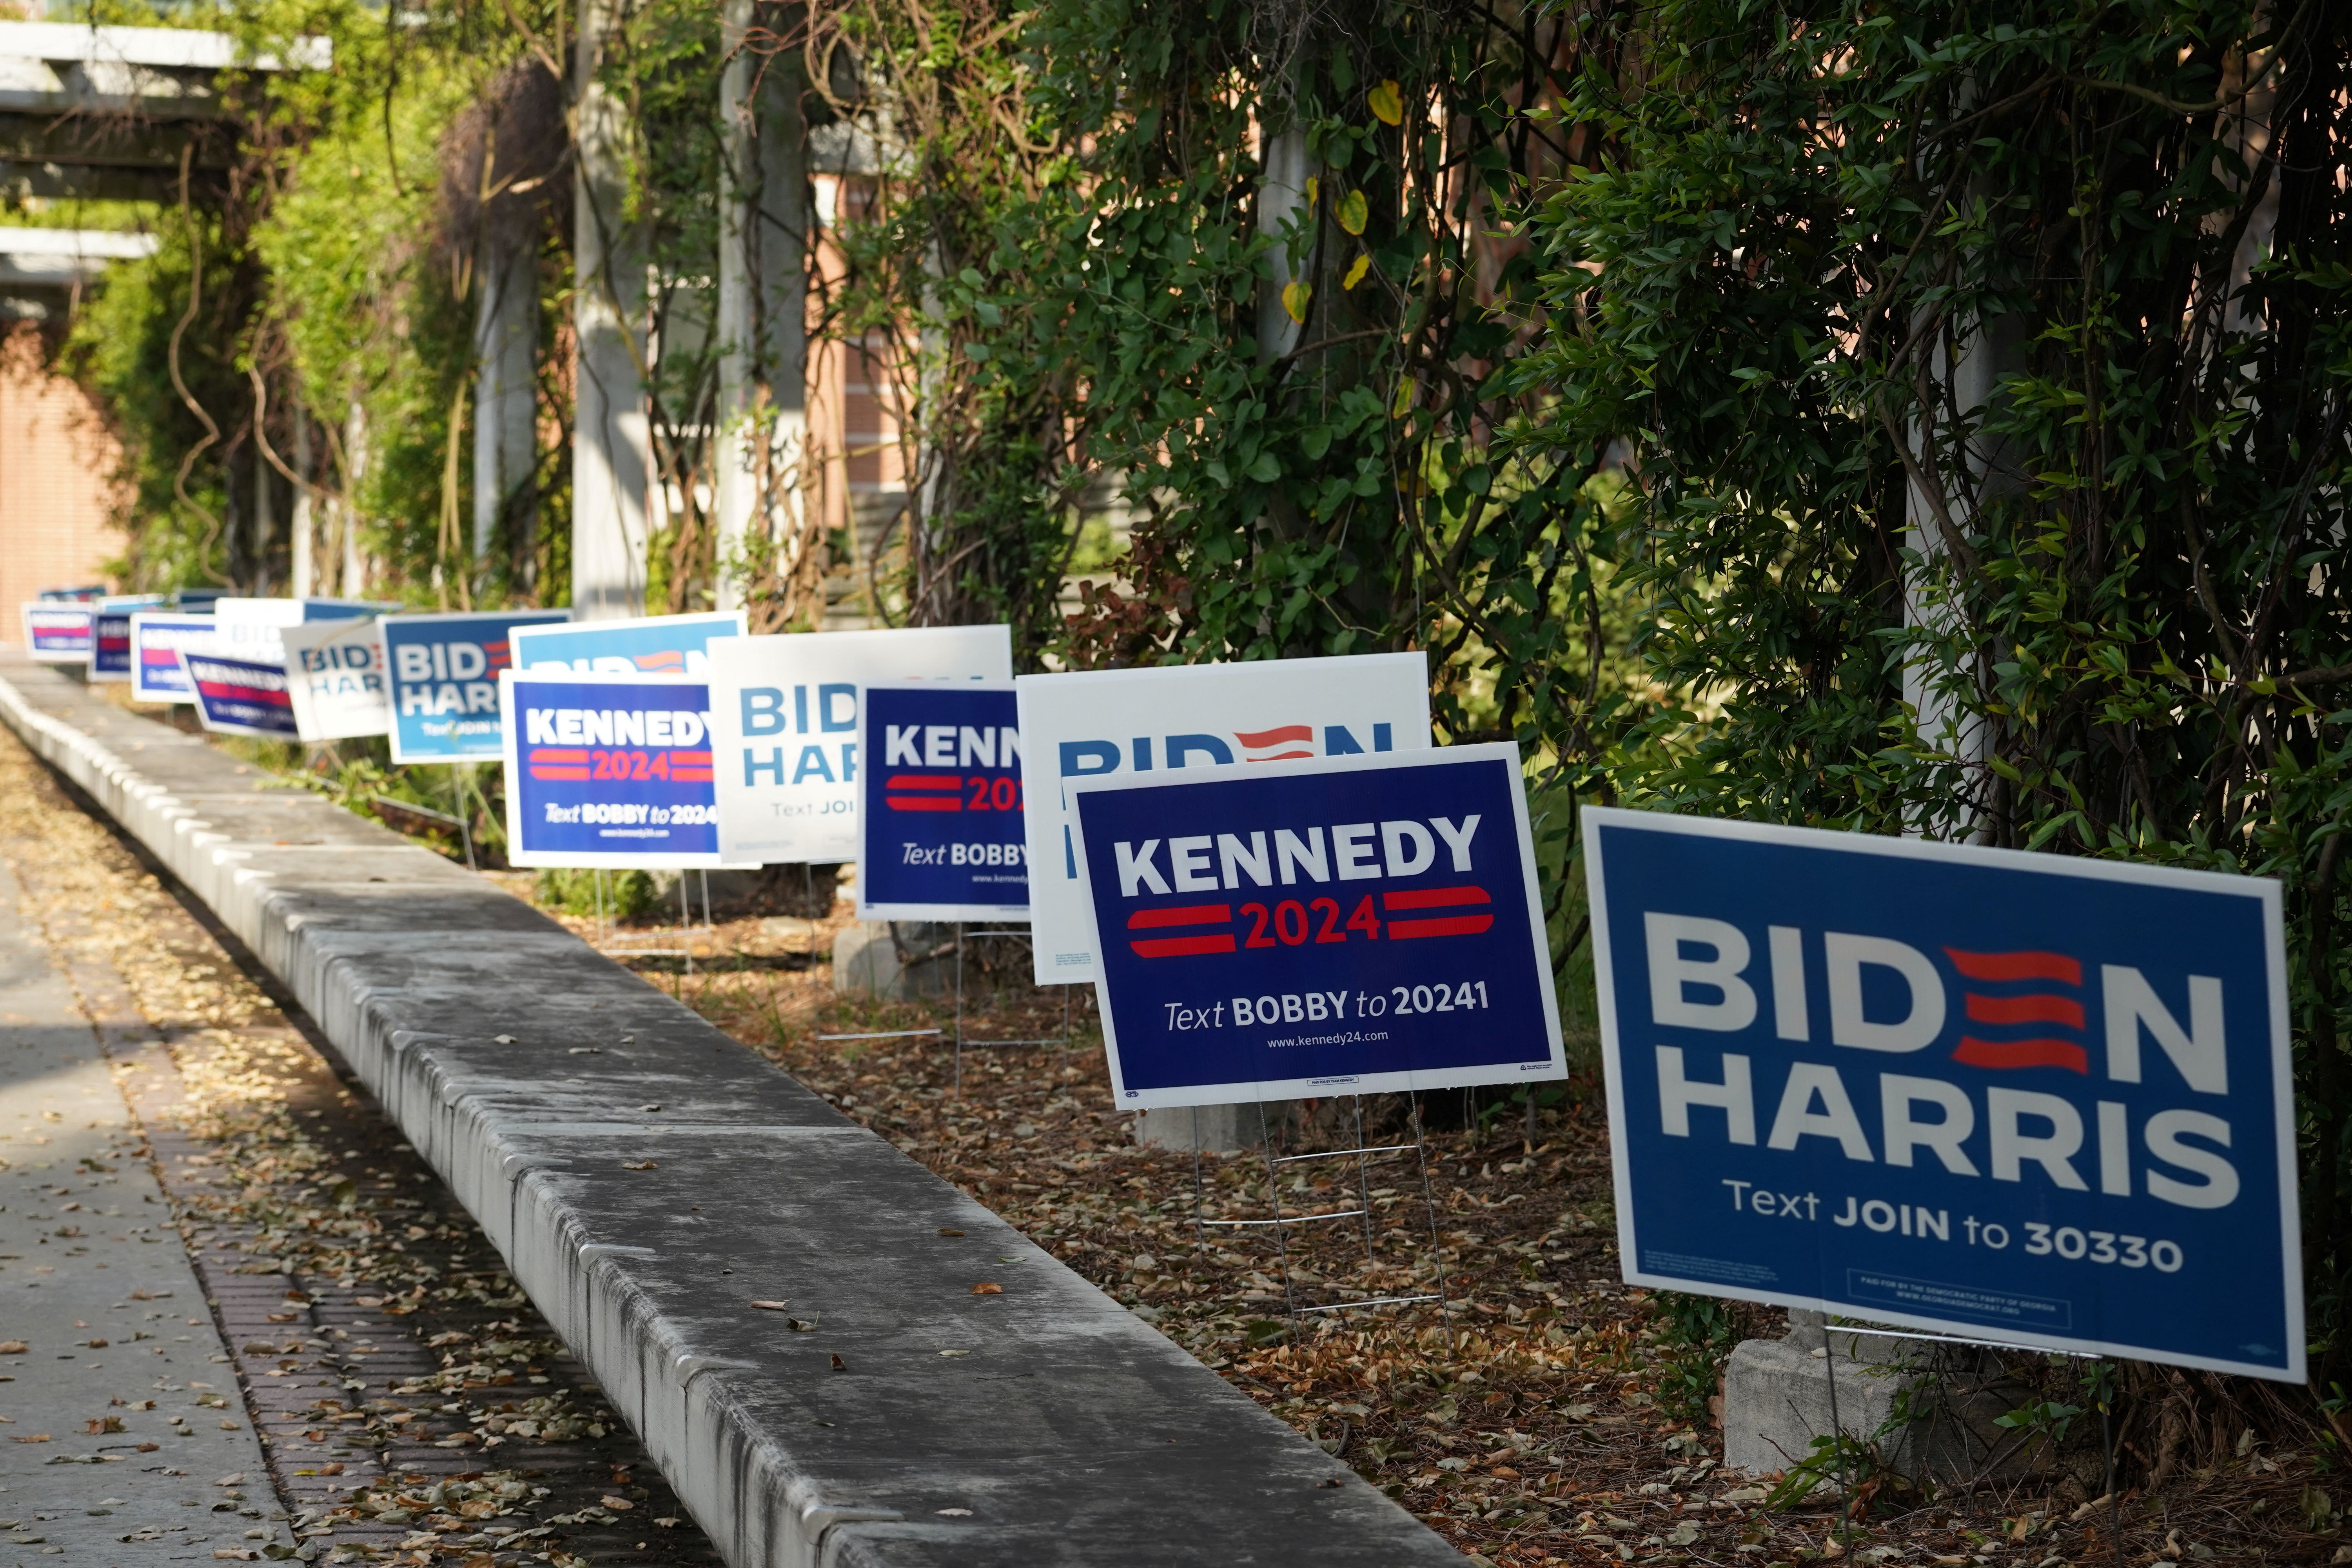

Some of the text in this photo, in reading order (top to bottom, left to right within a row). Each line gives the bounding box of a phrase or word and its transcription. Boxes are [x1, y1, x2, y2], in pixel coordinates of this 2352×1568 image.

[591, 750, 670, 781] 2024
[544, 803, 581, 823] Text
[582, 803, 650, 824] BOBBY
[650, 806, 670, 824] to
[967, 777, 1024, 811] 20
[902, 843, 947, 865] Text
[1114, 814, 1482, 897] KENNEDY
[1239, 894, 1381, 949] 2024
[1164, 980, 1489, 1031] Text BOBBY to 20241
[1643, 911, 2229, 1096] BIDEN
[1267, 1031, 1389, 1048] www.kennedy24.com
[1655, 1045, 2241, 1210] HARRIS
[1722, 1179, 2183, 1273] Text JOIN to 30330
